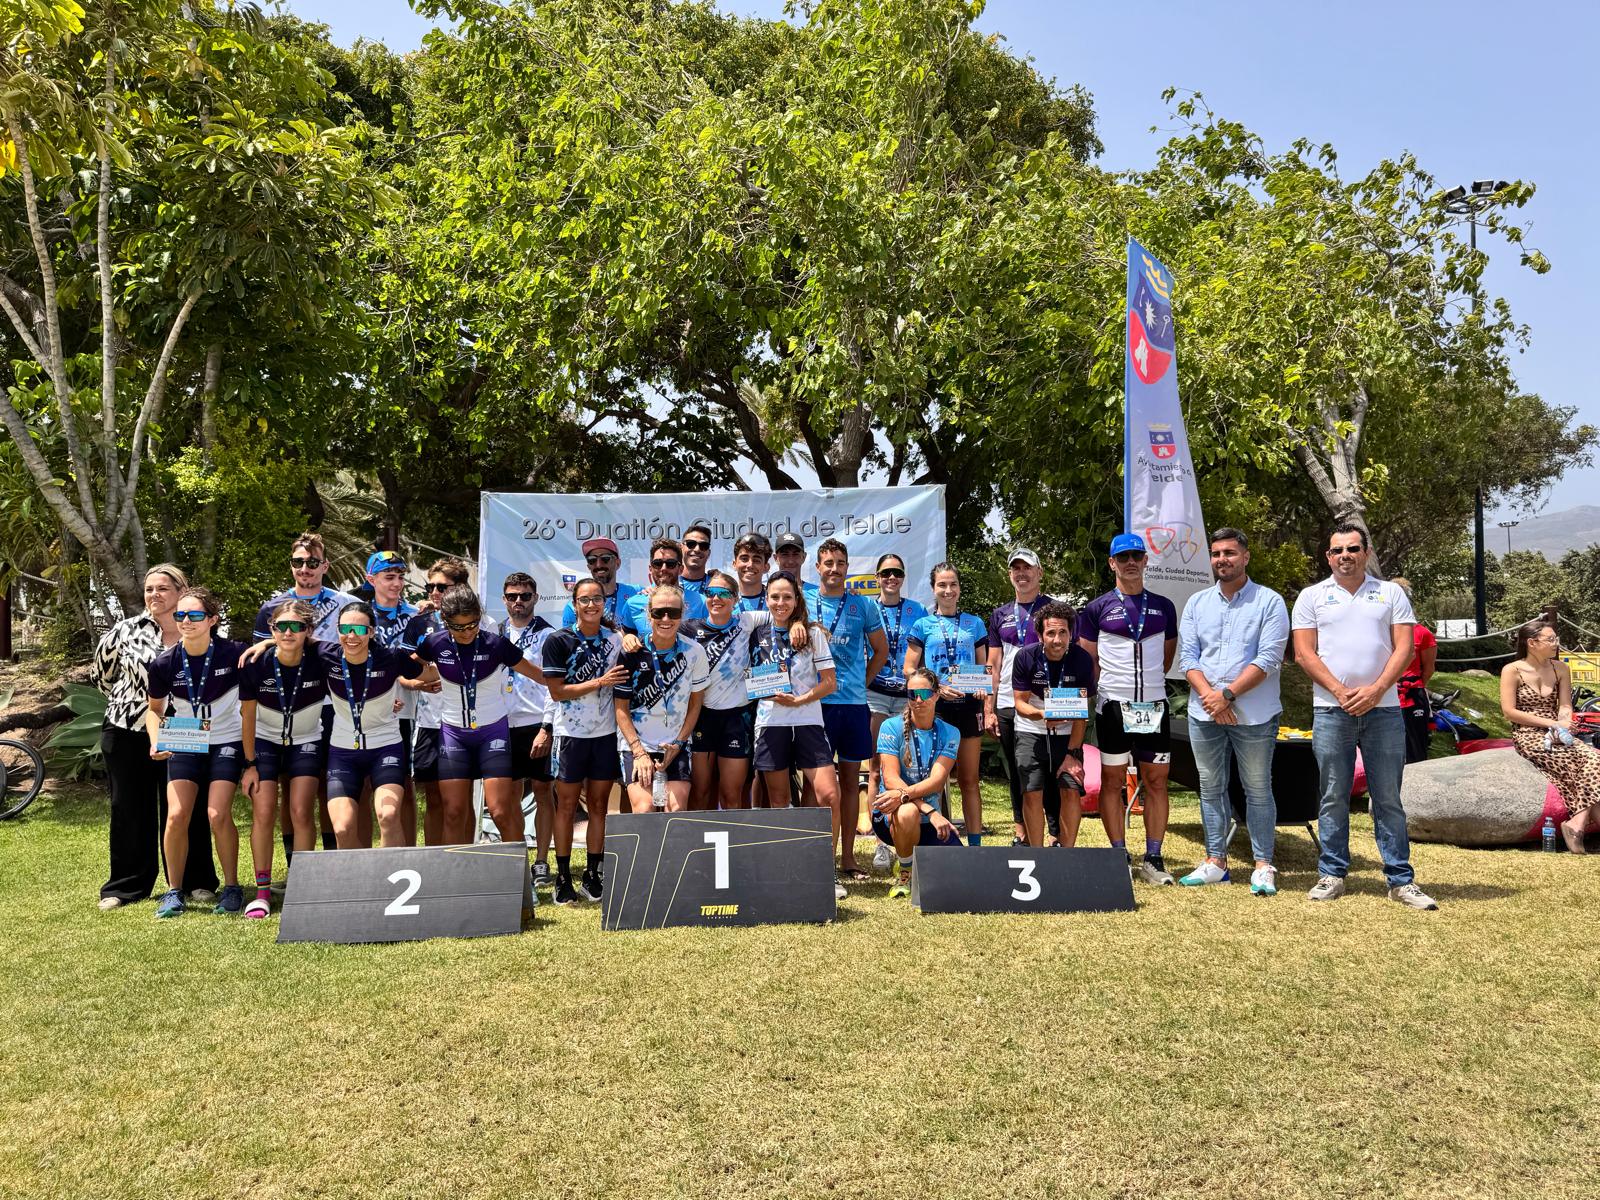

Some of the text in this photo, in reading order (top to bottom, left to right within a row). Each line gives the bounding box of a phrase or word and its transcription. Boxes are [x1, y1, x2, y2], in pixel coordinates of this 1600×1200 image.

[1150, 472, 1184, 483] elde
[576, 516, 680, 540] Duatlón
[801, 515, 836, 539] de
[841, 513, 912, 536] Telde
[846, 580, 880, 590] IKE
[1135, 711, 1150, 724] 34
[704, 831, 729, 889] 1
[1008, 860, 1041, 901] 3
[384, 869, 422, 916] 2
[700, 904, 739, 916] TOPTIME
